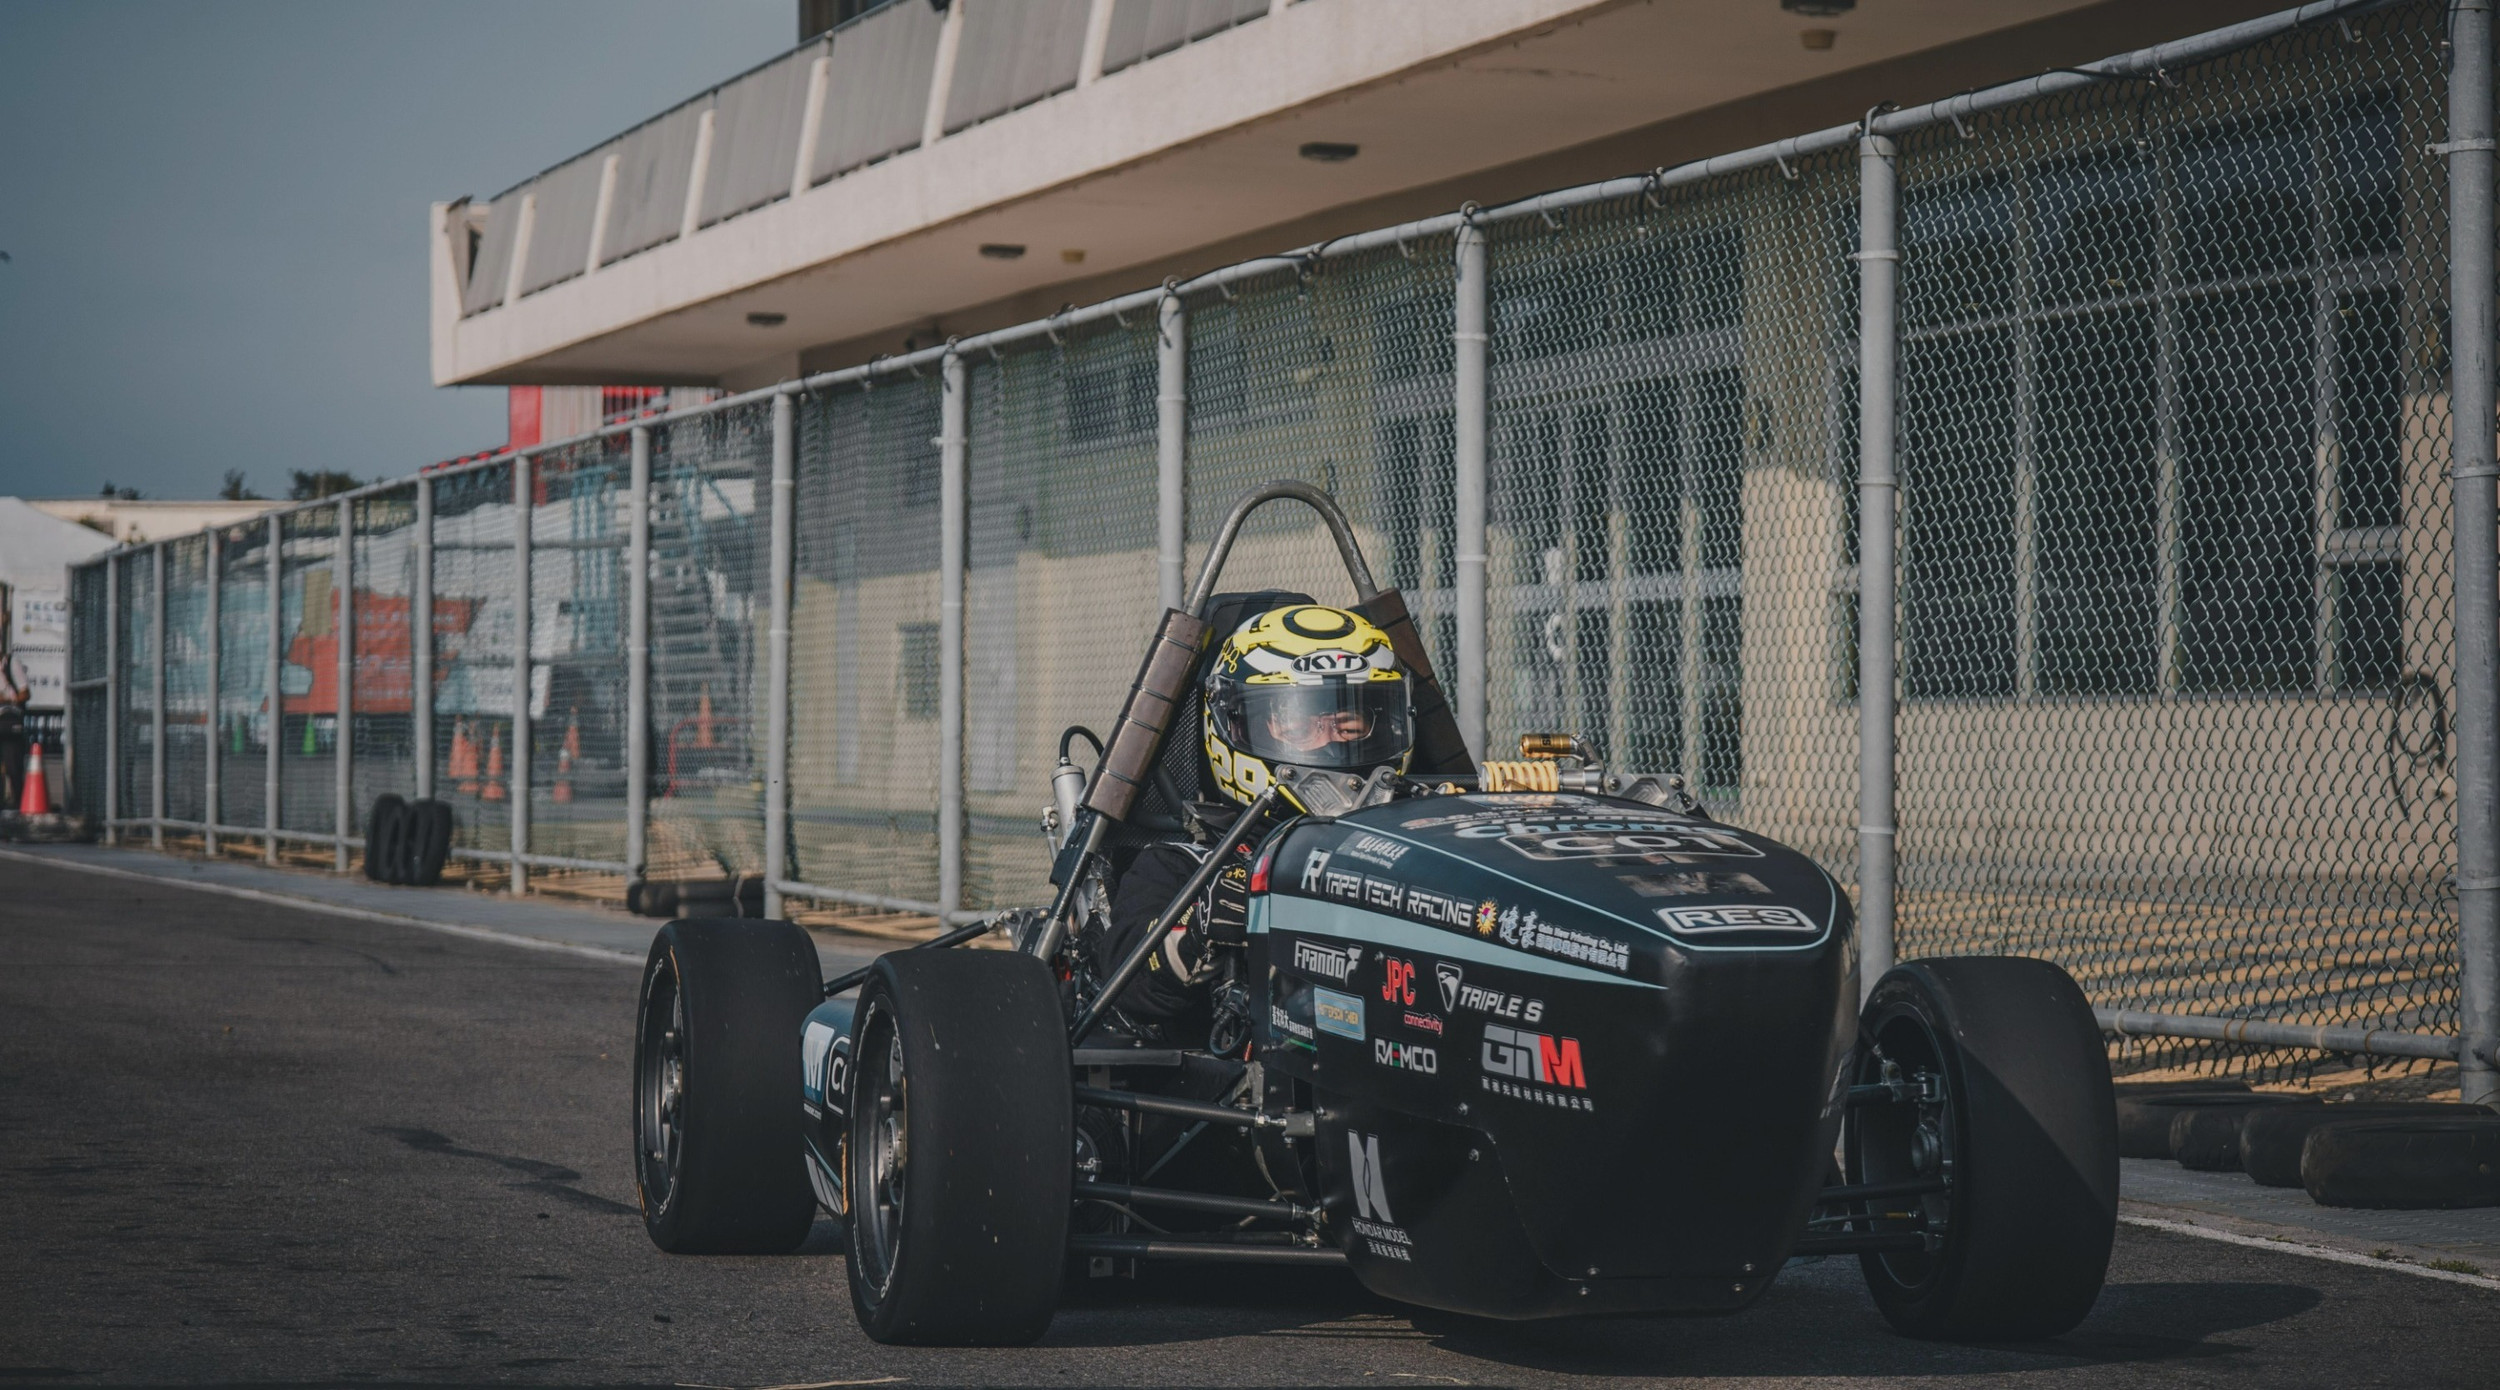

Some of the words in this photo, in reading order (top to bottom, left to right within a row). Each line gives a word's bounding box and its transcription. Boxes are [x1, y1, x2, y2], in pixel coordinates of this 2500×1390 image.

[1303, 654, 1358, 670] KYT
[1364, 878, 1404, 910] TECH
[1406, 889, 1474, 928] RACING
[1683, 908, 1793, 926] RES
[1382, 958, 1416, 1006] JPC
[1459, 986, 1520, 1018] TRIPLE
[1524, 1000, 1544, 1023] S
[1404, 1012, 1443, 1035] connectivity
